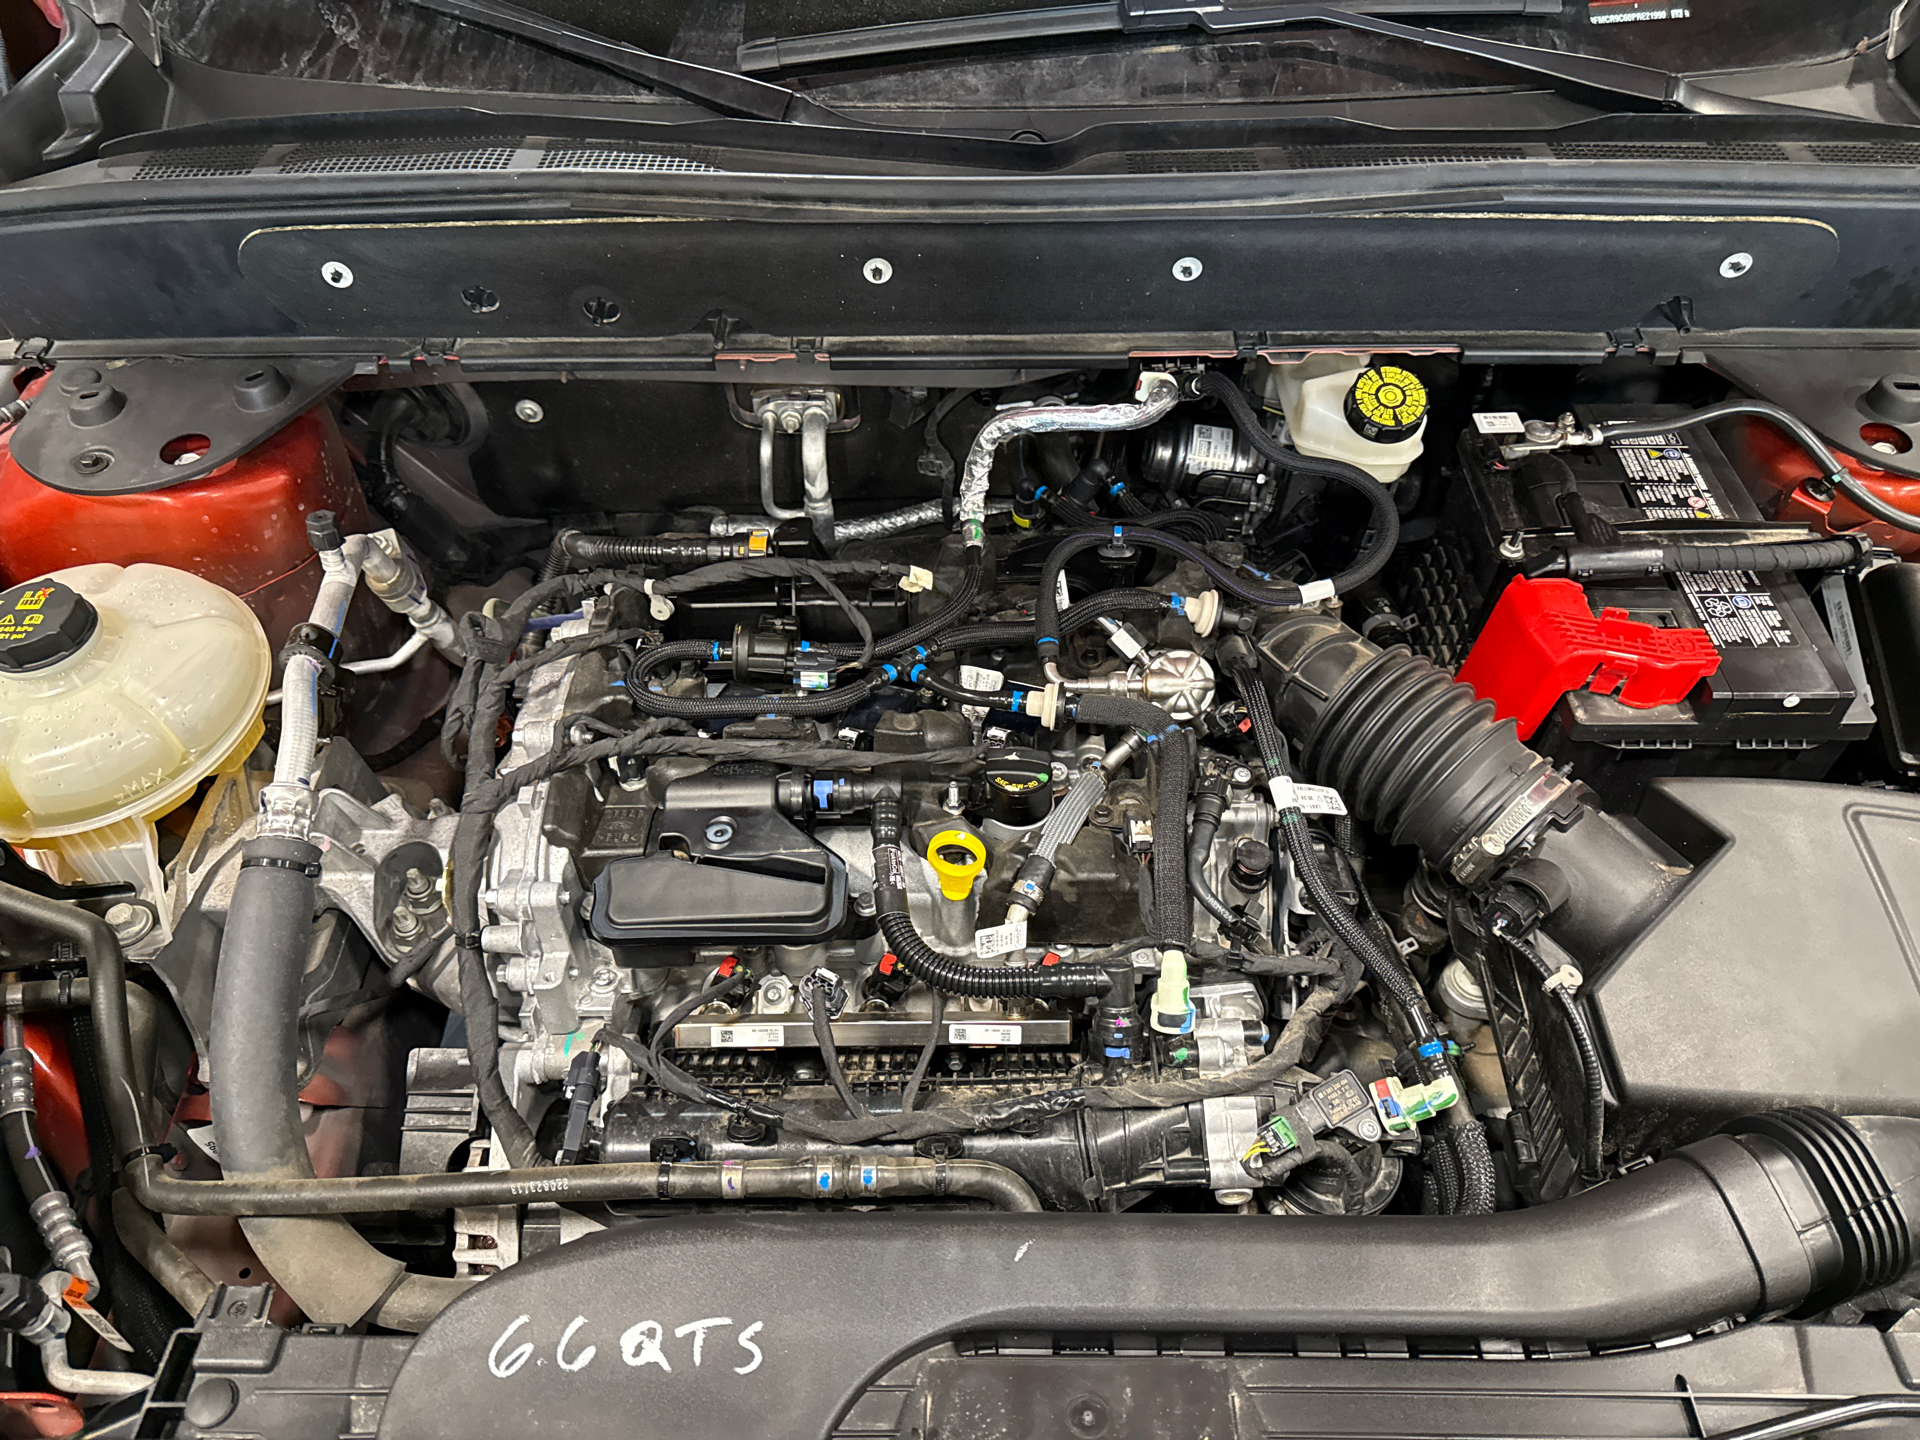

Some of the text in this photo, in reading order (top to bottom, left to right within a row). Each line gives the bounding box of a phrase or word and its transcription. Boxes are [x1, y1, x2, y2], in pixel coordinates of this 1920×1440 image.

[122, 767, 172, 798] MAX
[994, 776, 1010, 787] SAE
[488, 1303, 764, 1378] 6.6 QTS
